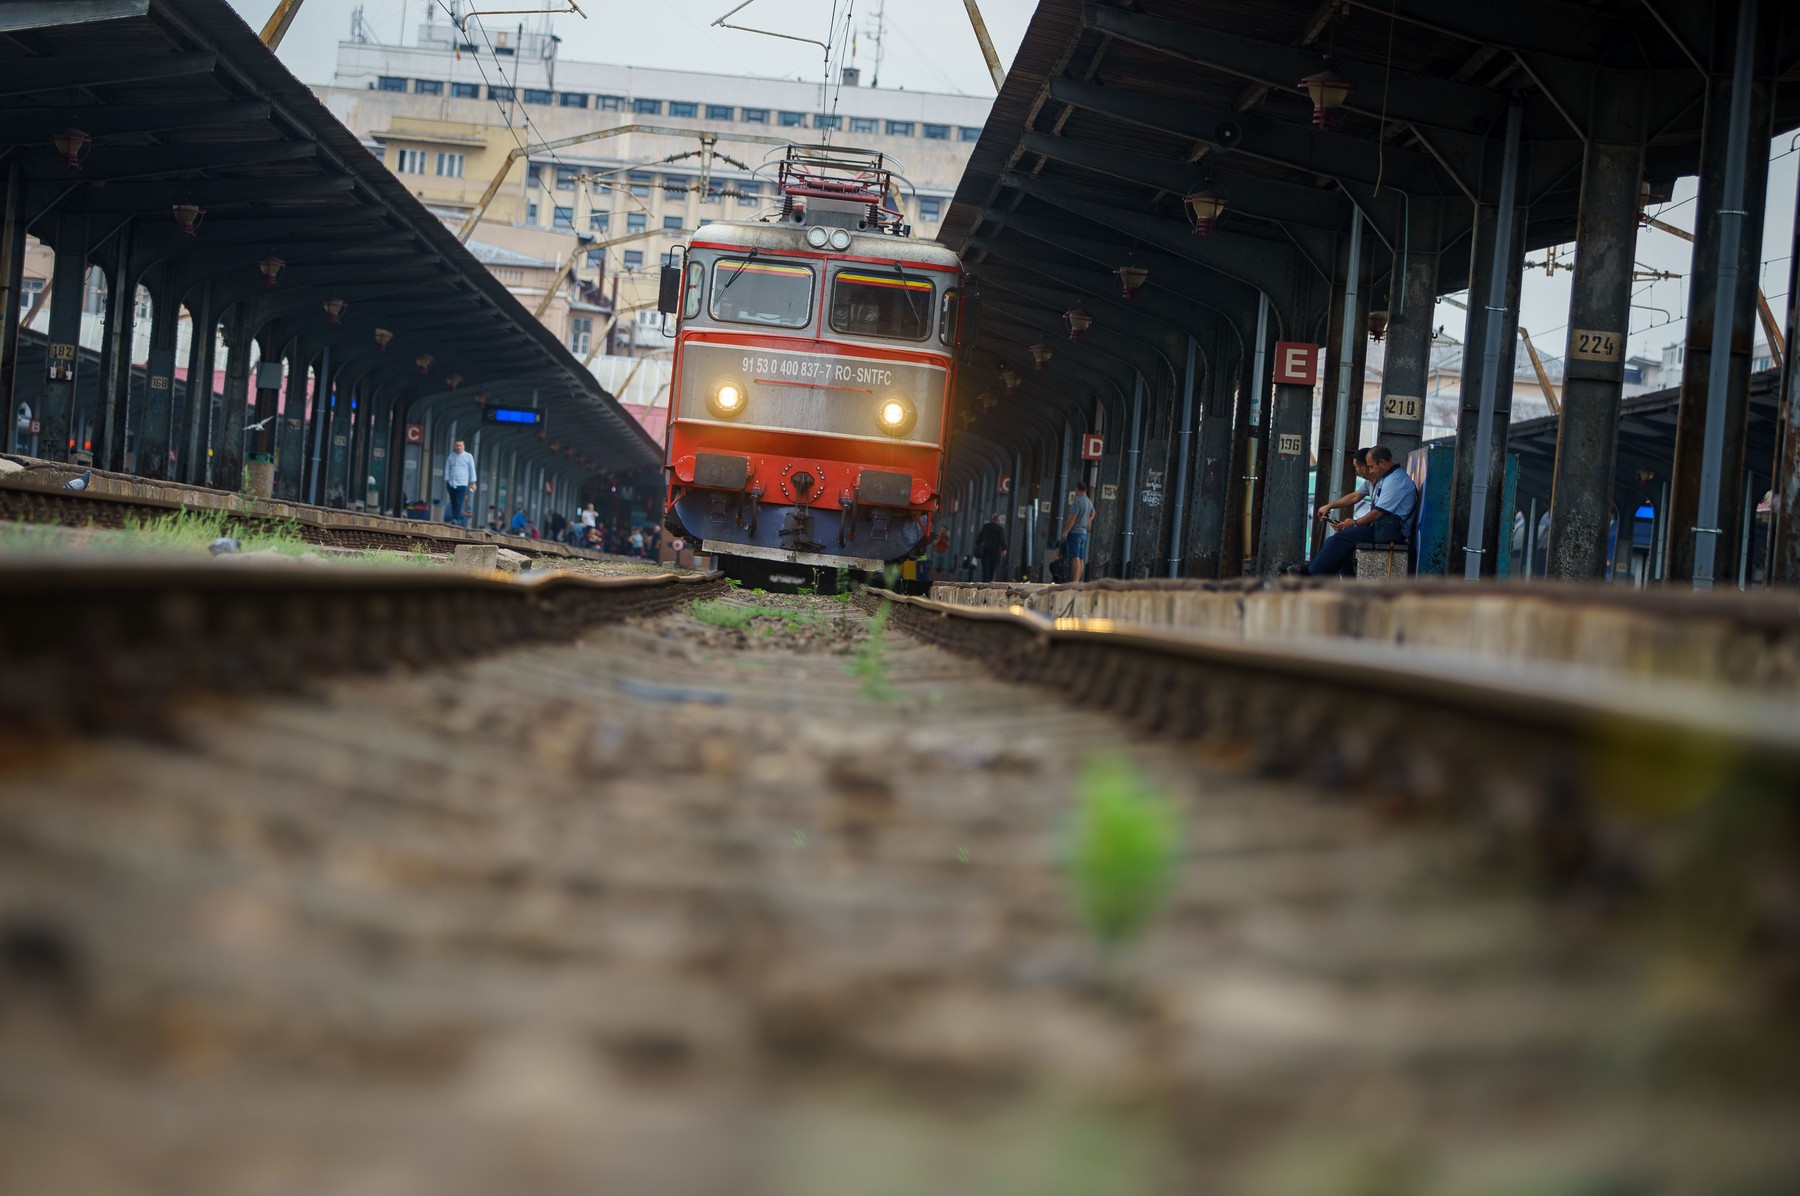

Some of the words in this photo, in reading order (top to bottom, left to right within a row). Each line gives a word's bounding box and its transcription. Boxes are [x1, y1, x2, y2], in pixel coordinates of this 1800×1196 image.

[53, 345, 73, 357] 182
[1578, 334, 1614, 355] 224
[1284, 348, 1308, 378] E
[742, 357, 754, 373] 91
[756, 358, 769, 374] 53
[771, 359, 778, 374] 0
[780, 360, 799, 376] 400
[800, 361, 832, 379] 837-7
[835, 365, 892, 386] RO-SNTFC
[152, 377, 168, 388] 168
[1388, 399, 1415, 416] 210
[31, 422, 40, 432] B
[408, 427, 420, 440] C
[1089, 438, 1103, 457] D
[1280, 438, 1300, 451] 196
